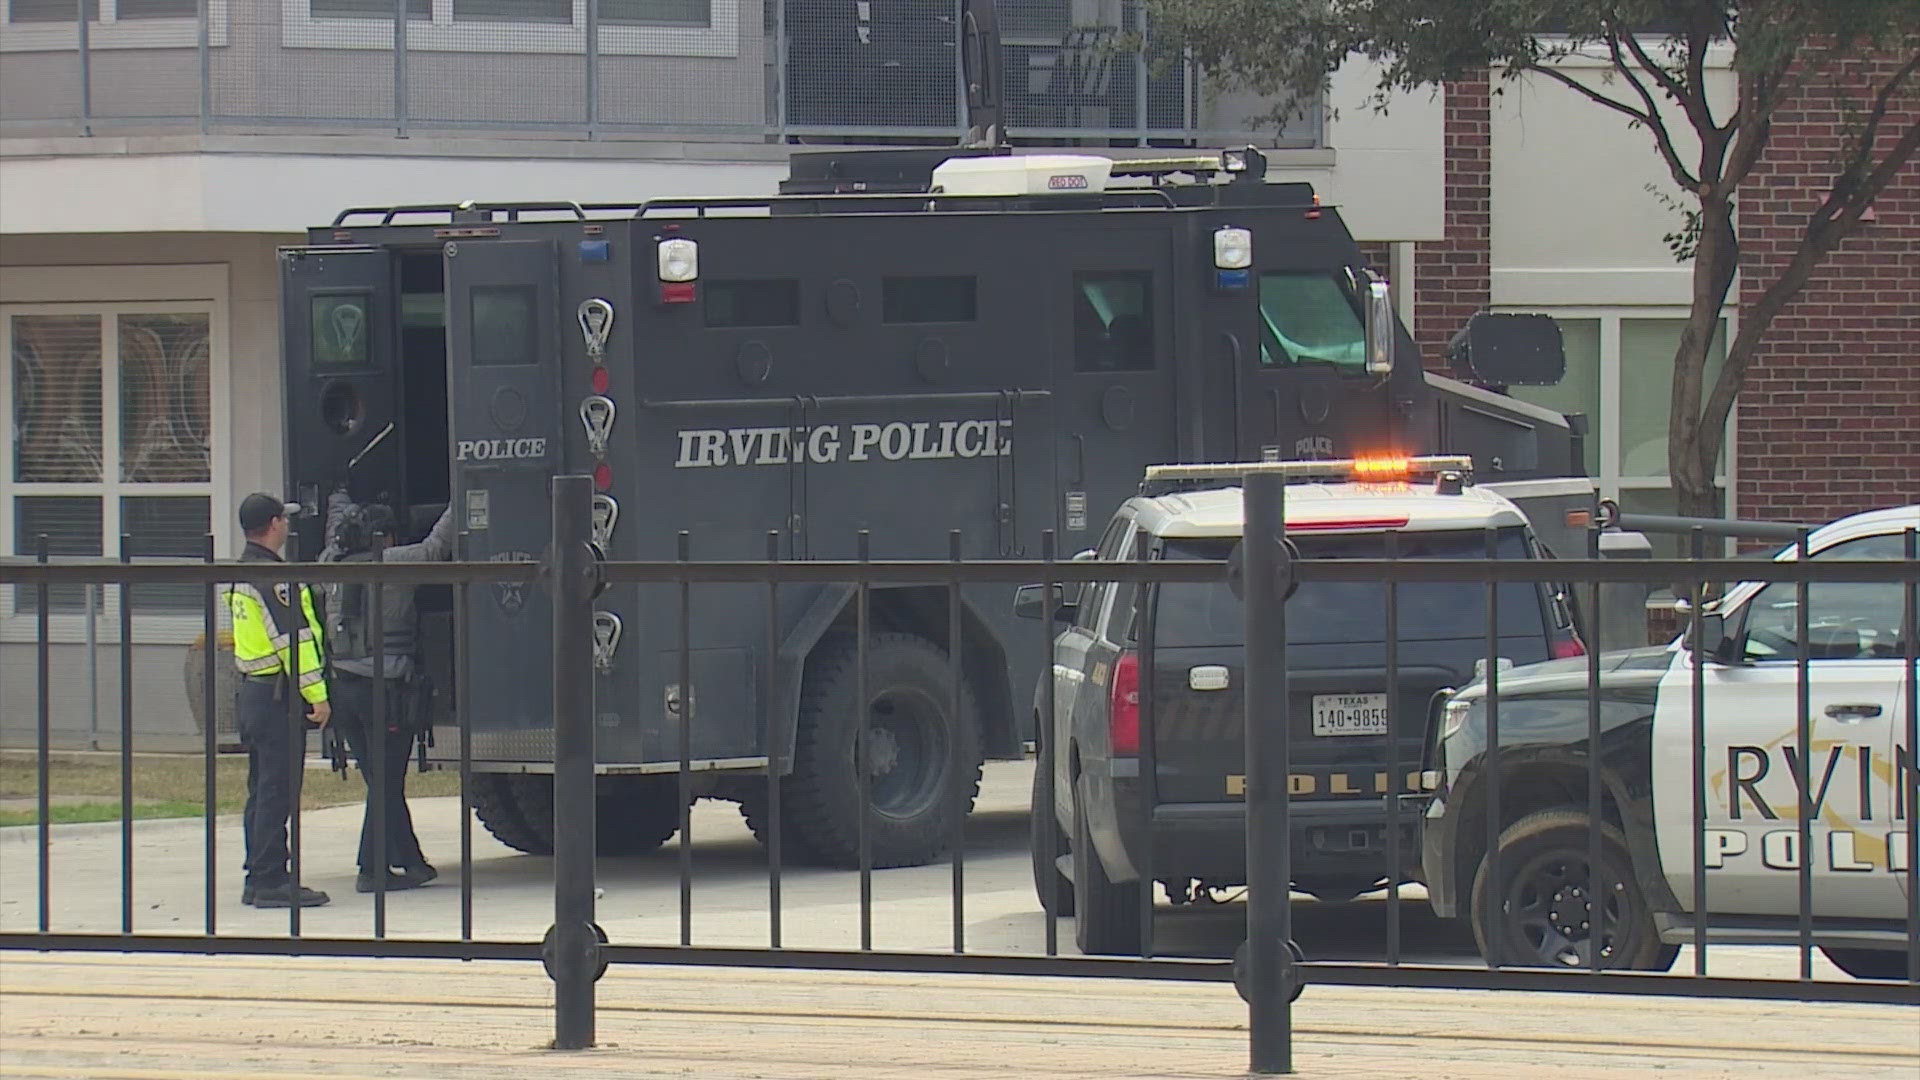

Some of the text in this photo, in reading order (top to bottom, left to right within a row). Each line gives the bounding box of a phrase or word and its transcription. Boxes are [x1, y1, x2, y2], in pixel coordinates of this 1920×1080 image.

[1051, 177, 1085, 188] RED DOT
[456, 438, 547, 461] POLICE
[674, 419, 1013, 468] IRVING POLICE
[1338, 696, 1369, 705] TEXAS
